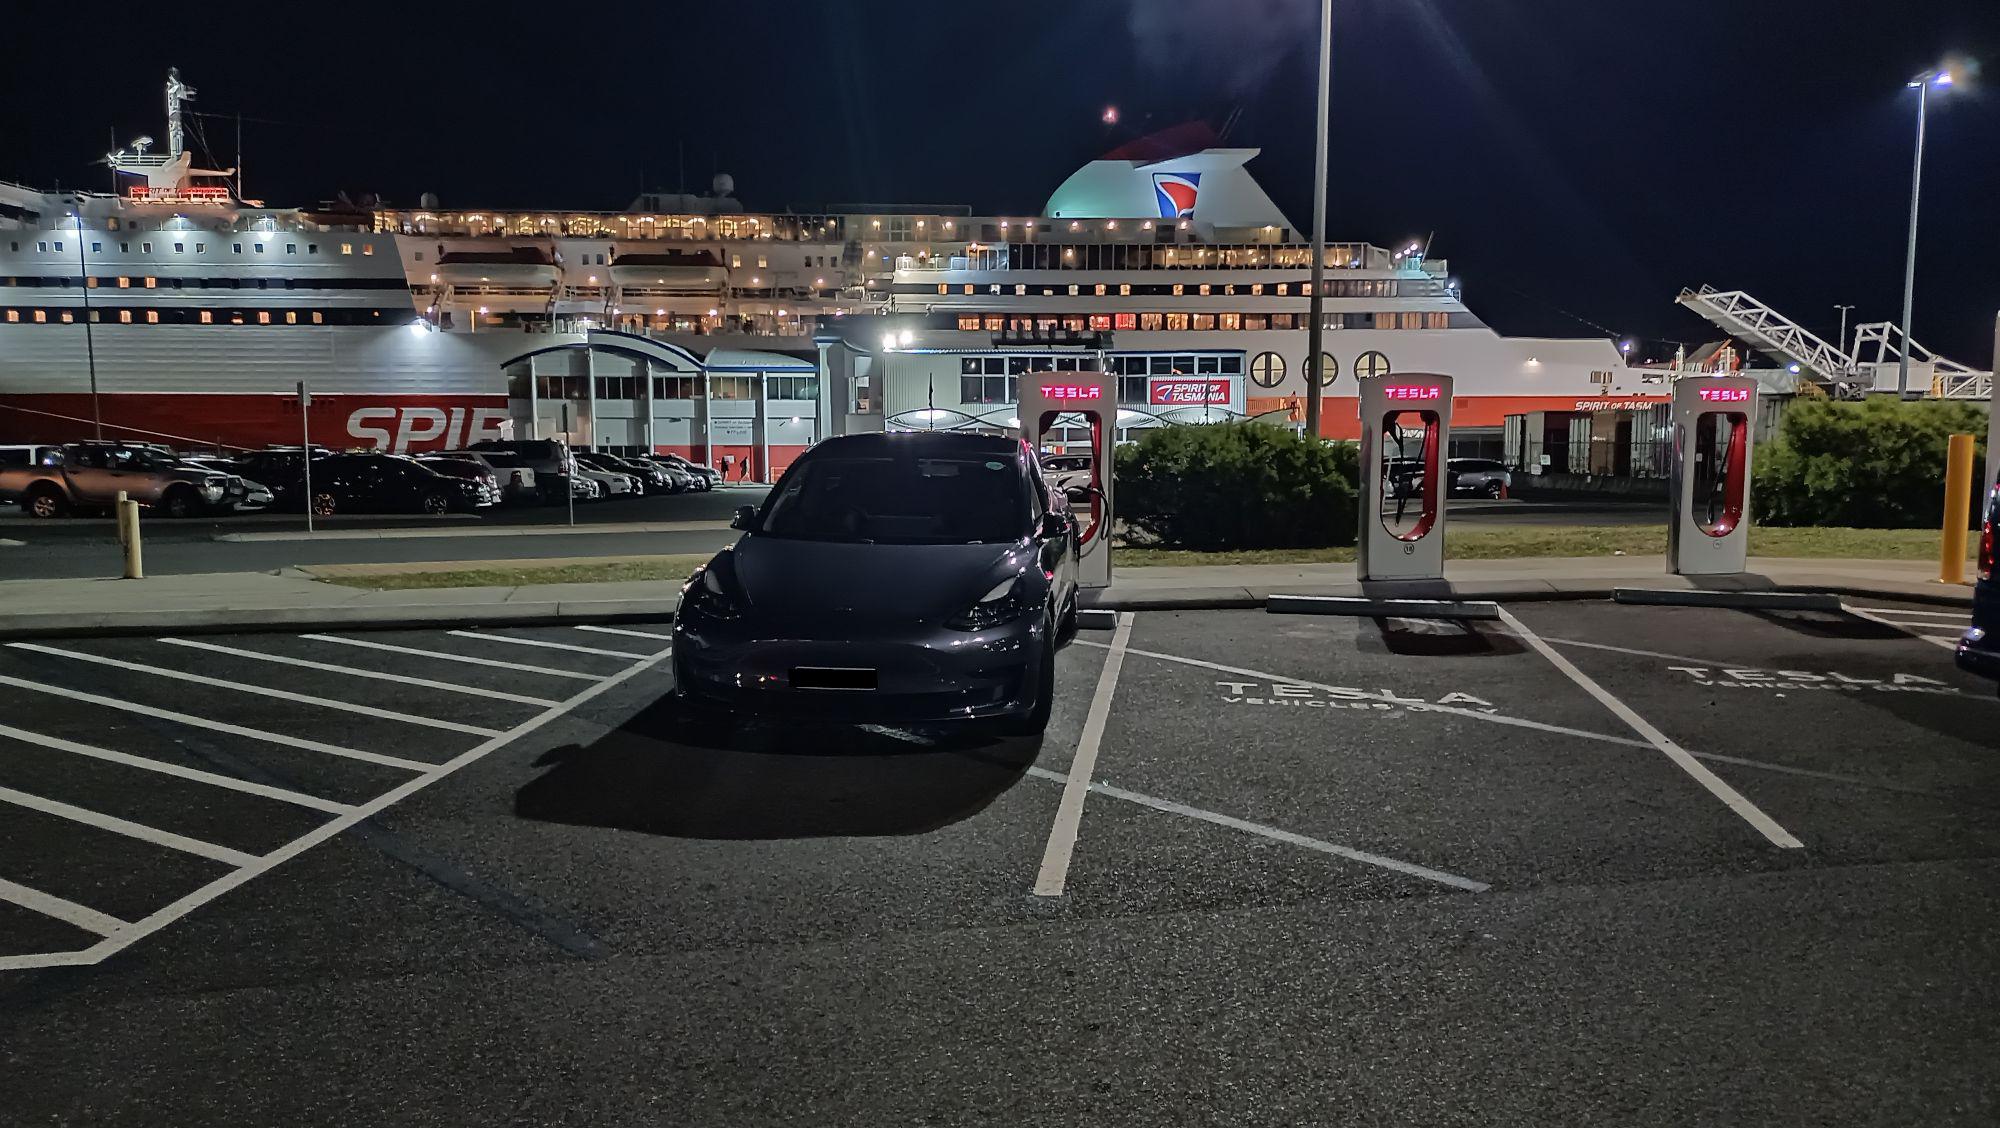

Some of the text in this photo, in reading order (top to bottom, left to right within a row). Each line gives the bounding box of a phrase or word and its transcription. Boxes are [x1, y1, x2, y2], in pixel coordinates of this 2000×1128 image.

[1041, 387, 1100, 398] TESLA
[1173, 383, 1221, 393] SPIRIT OF
[1385, 388, 1439, 399] TESLA
[1699, 390, 1748, 401] TESLA
[1574, 401, 1610, 411] SPIRIT
[1610, 402, 1623, 410] OF
[1667, 666, 1948, 685] TESLA
[1214, 681, 1493, 706] TESLA
[1220, 696, 1498, 714] VEHICLES OY
